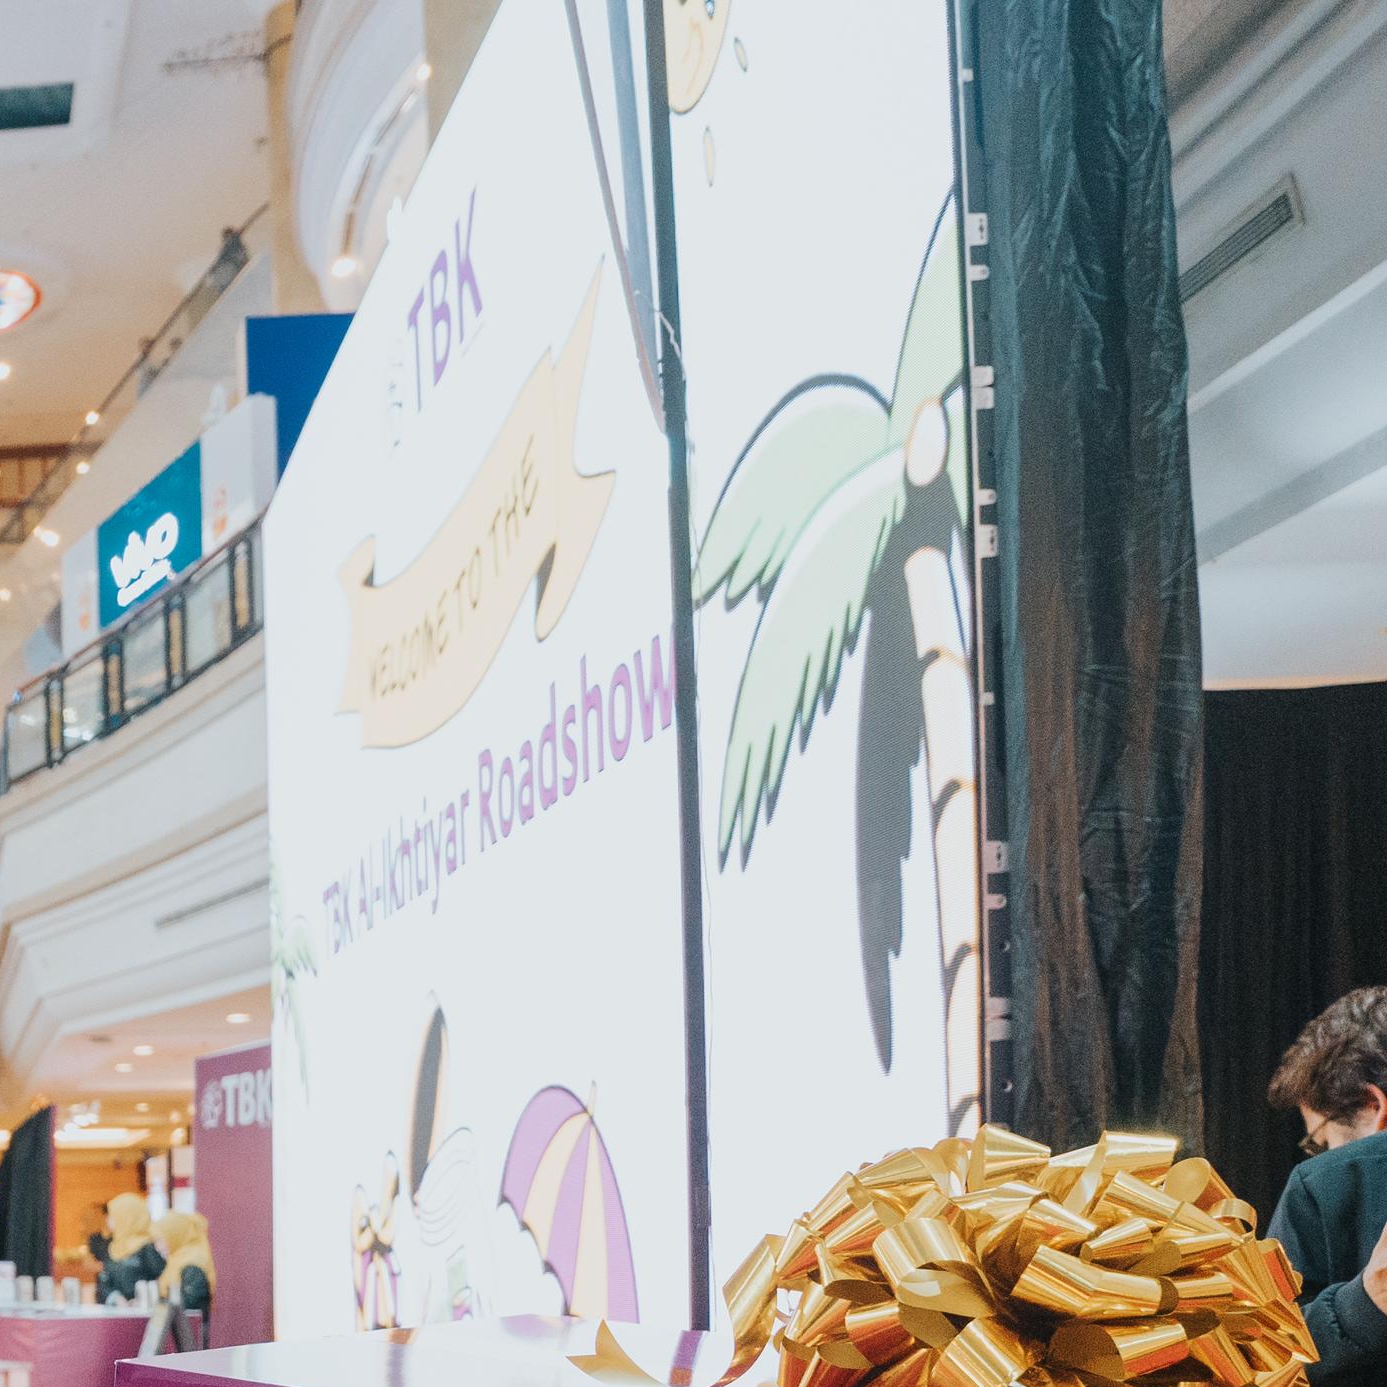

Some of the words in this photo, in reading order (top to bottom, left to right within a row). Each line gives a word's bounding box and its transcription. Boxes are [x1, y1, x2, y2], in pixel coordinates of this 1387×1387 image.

[408, 184, 483, 414] TBK
[370, 589, 449, 702] WELCOME
[454, 545, 483, 633] TO
[489, 433, 539, 578] THE
[322, 870, 354, 954] TBK
[358, 789, 470, 937] Al-Ikhtiyar
[478, 618, 677, 852] Roadshow
[221, 1068, 272, 1127] TBK
